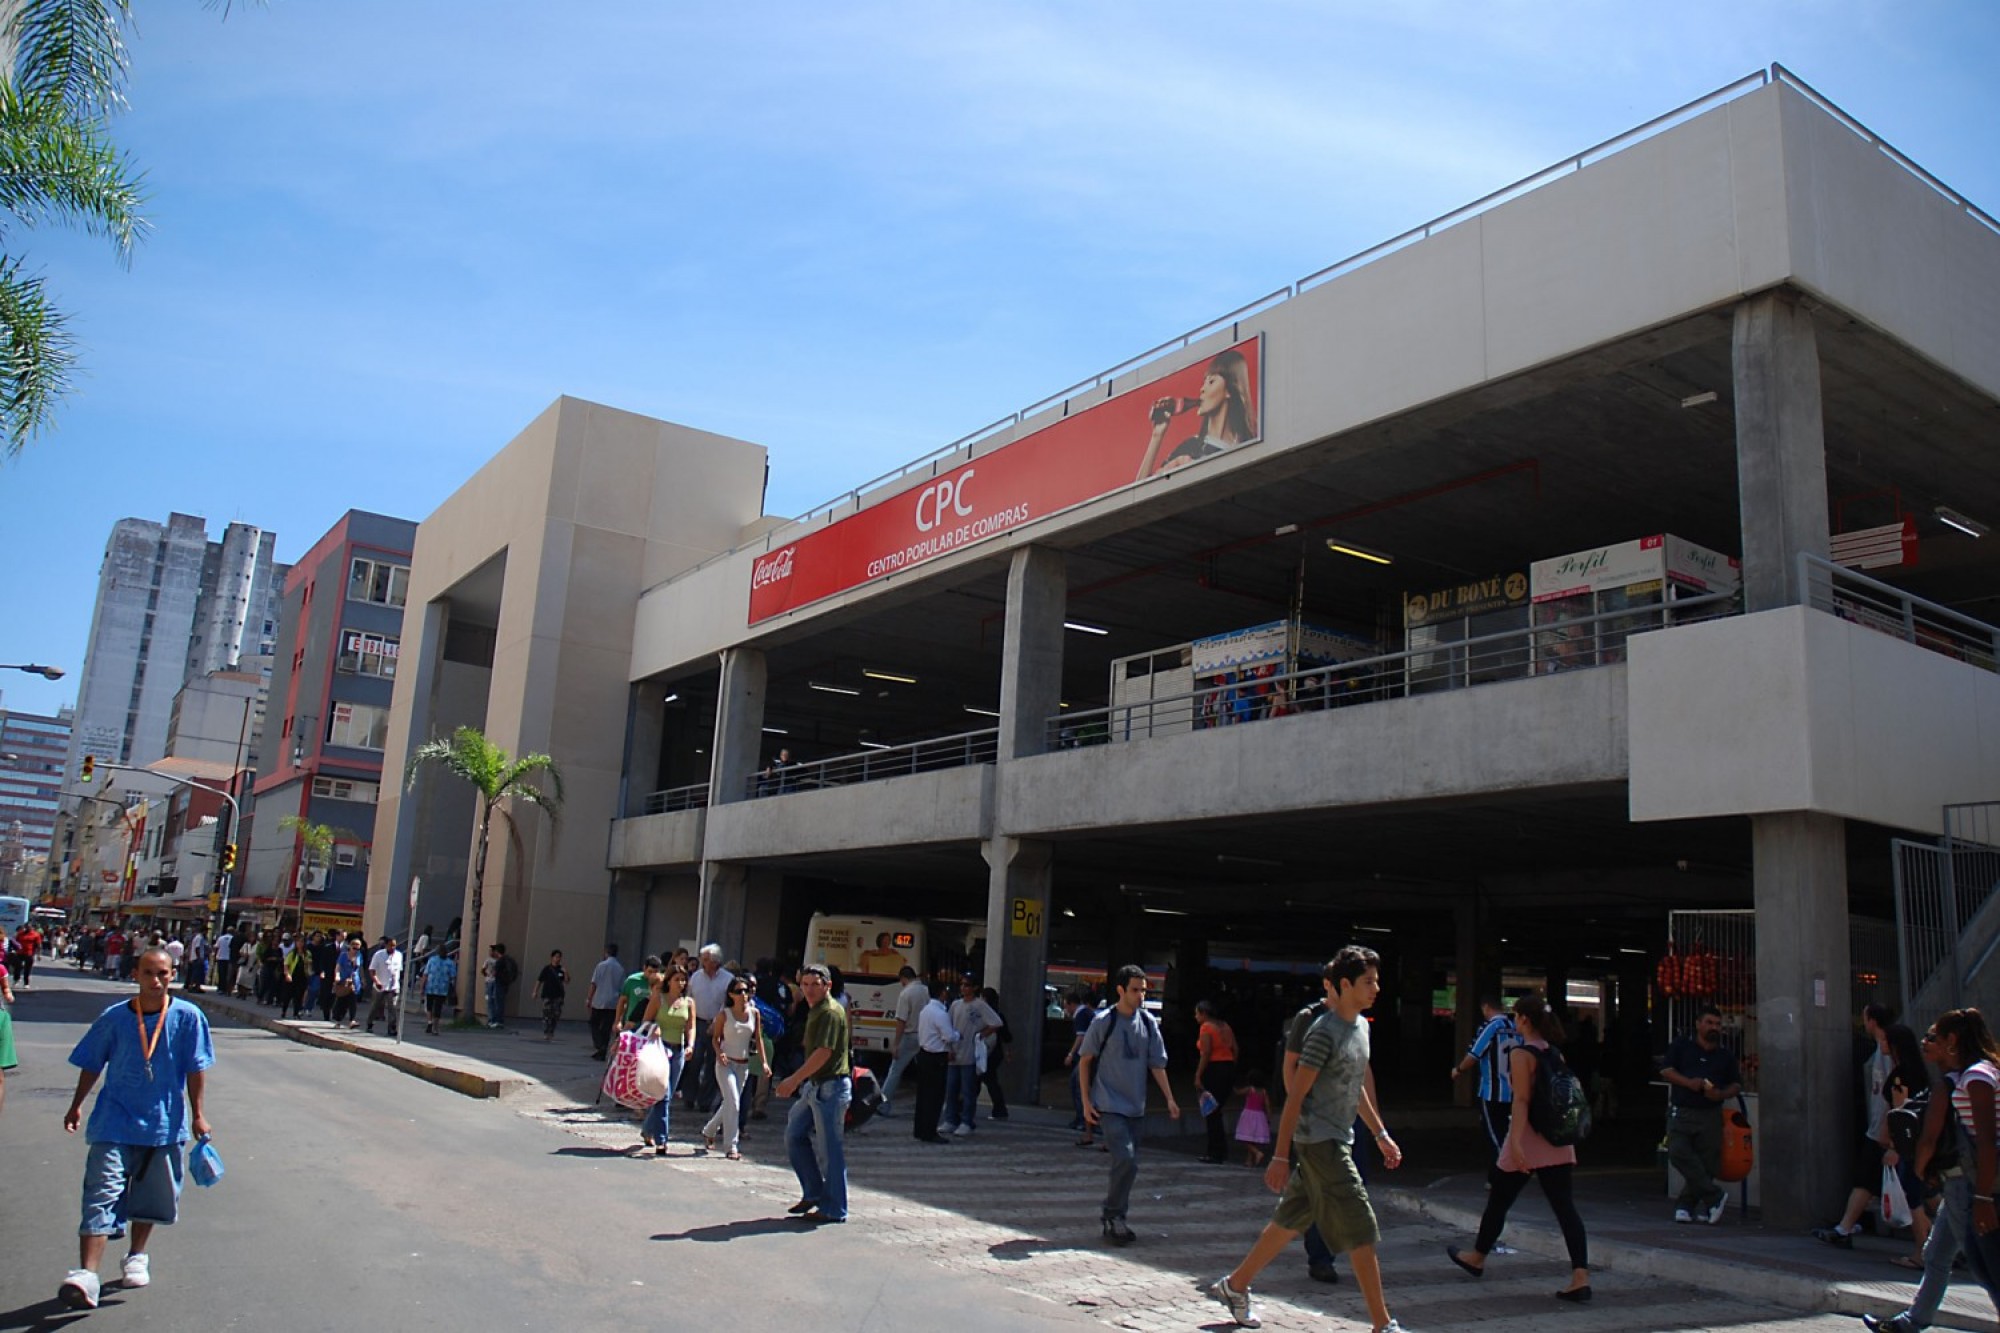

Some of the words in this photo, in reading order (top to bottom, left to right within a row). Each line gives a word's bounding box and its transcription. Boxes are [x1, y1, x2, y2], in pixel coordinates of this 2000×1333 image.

[916, 469, 975, 532] CPC
[867, 551, 905, 577] CENTRO
[906, 535, 953, 564] POPULAR
[955, 525, 970, 545] DE
[971, 502, 1029, 538] COMPRAS
[752, 546, 797, 589] Coca-Cola
[1556, 549, 1609, 577] Perfil
[1430, 589, 1453, 610] DU
[1506, 577, 1524, 596] 74
[1014, 900, 1026, 920] B
